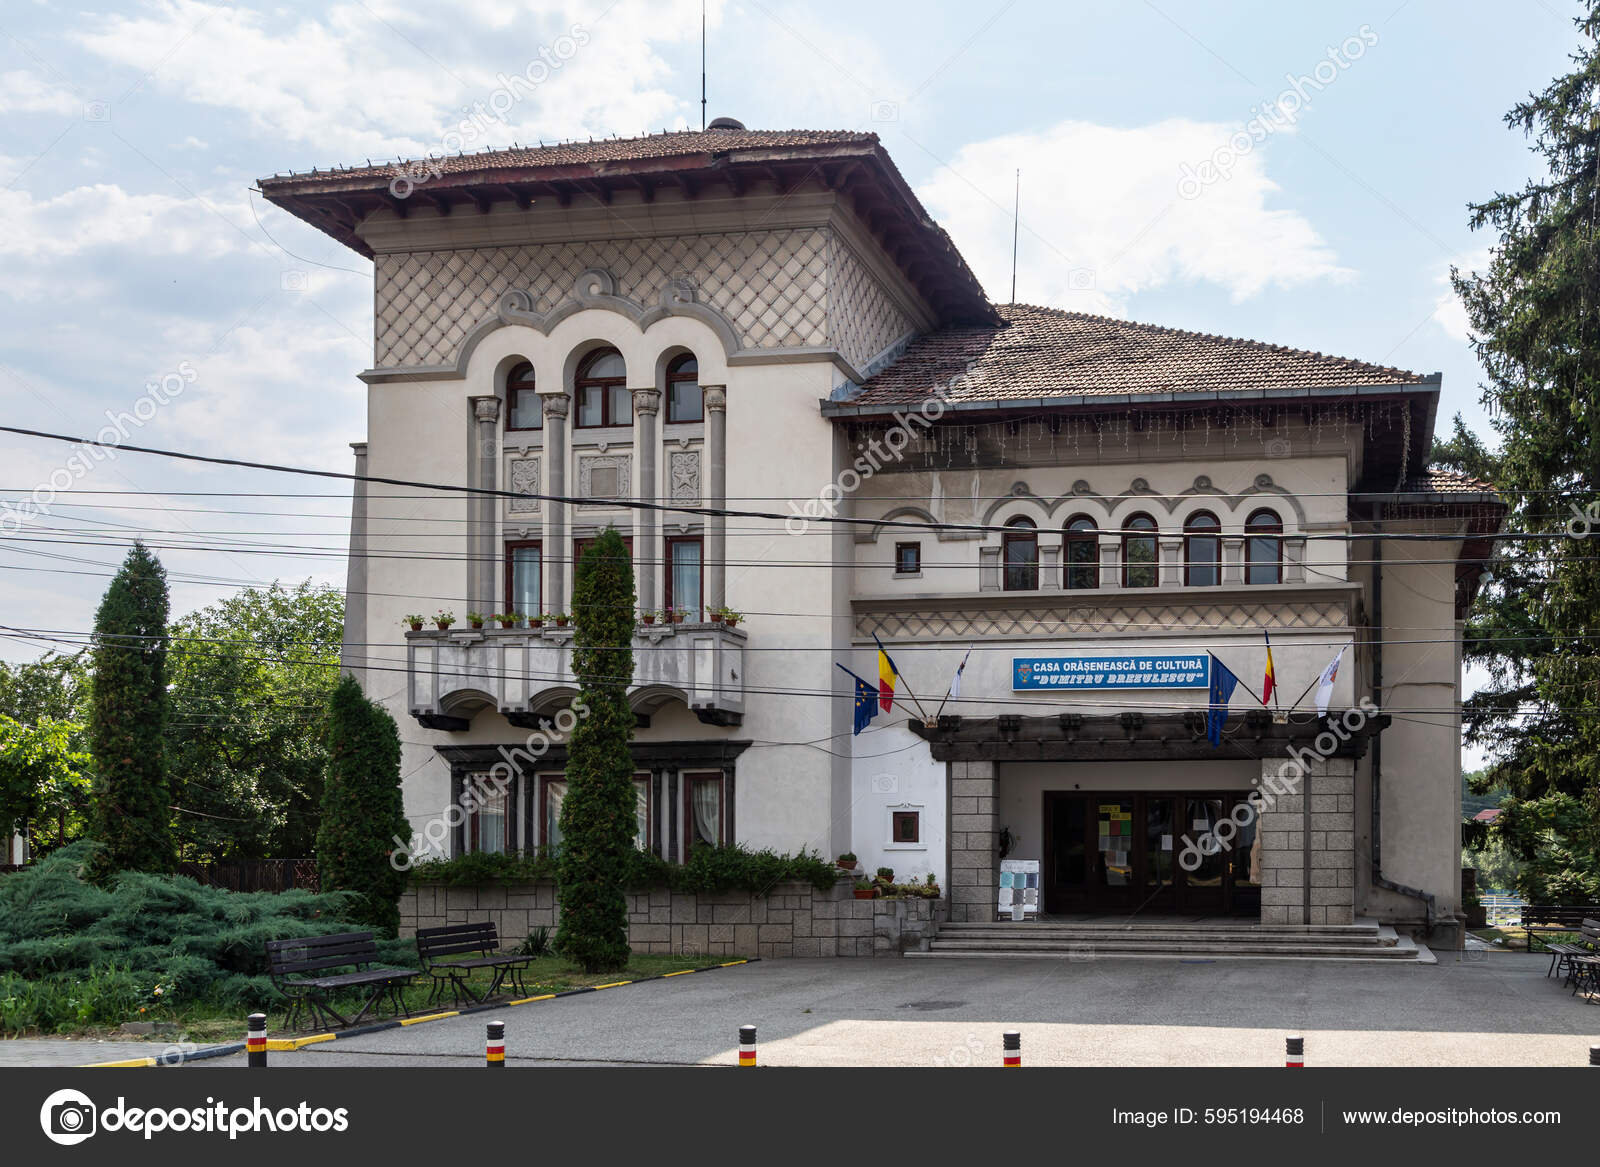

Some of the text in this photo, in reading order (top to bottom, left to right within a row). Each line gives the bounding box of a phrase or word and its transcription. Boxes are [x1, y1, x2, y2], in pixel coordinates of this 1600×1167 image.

[1033, 662, 1060, 672] CASA
[1139, 661, 1153, 670] DE
[1155, 659, 1203, 670] CULTURĂ
